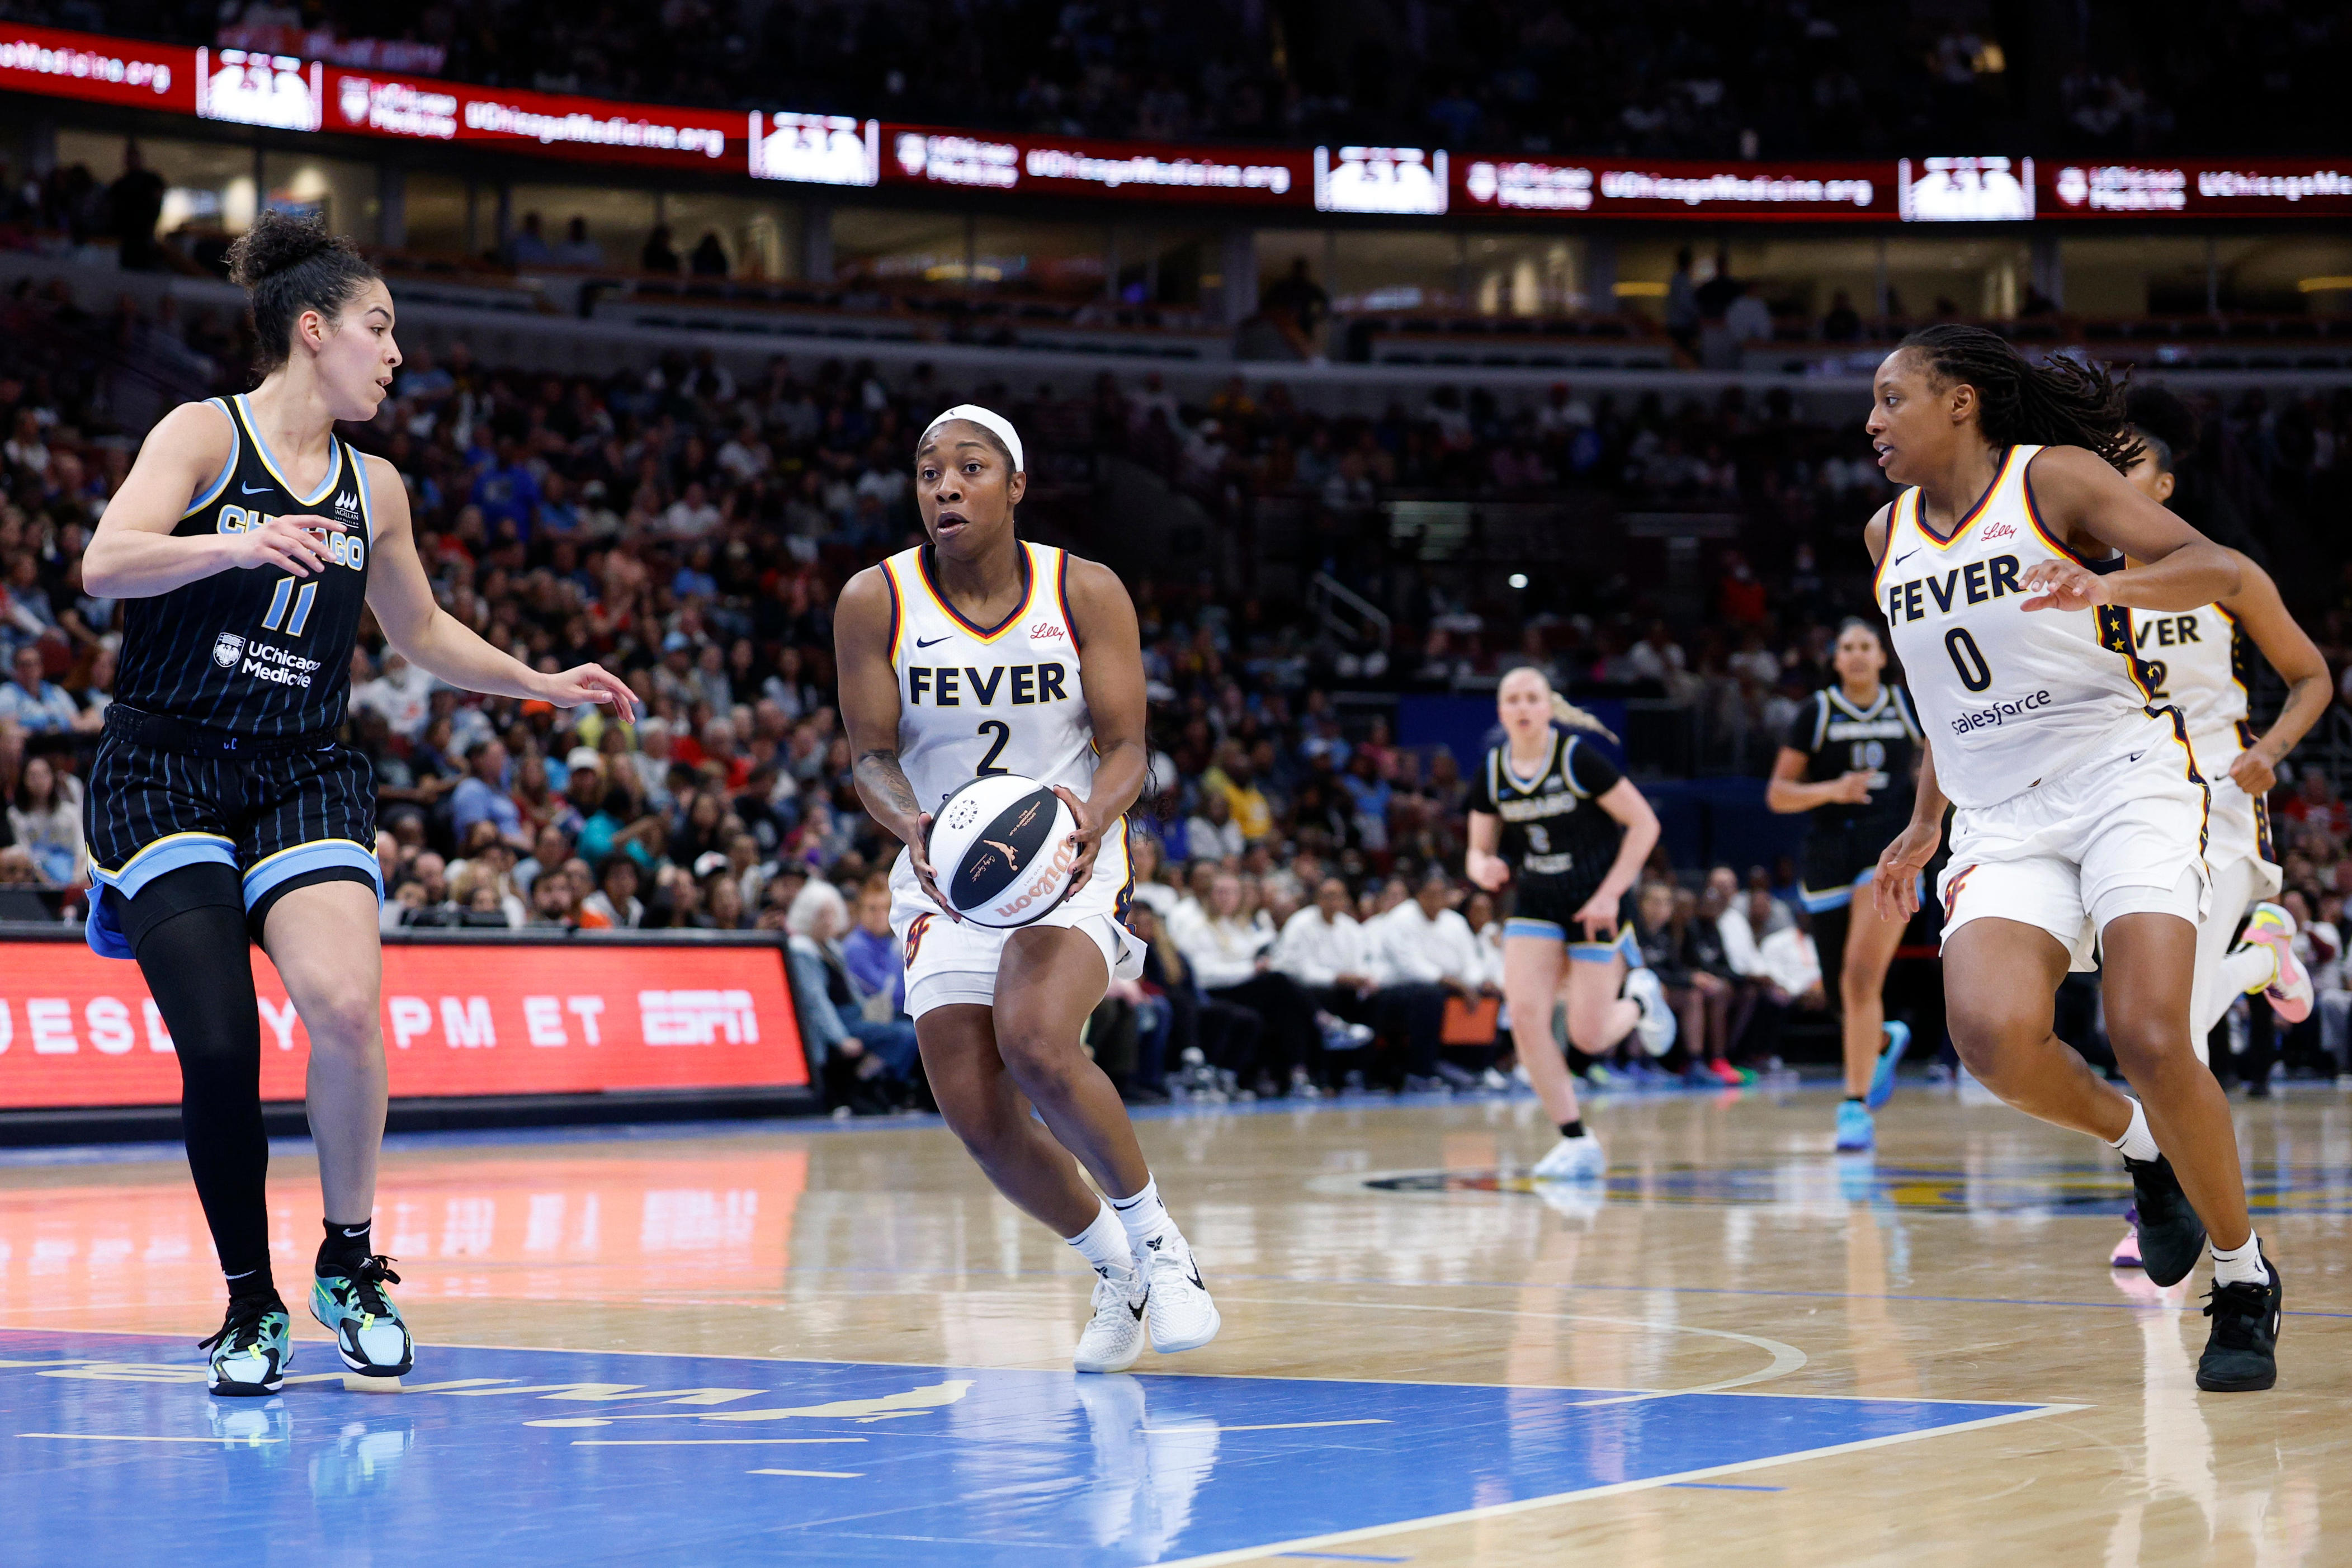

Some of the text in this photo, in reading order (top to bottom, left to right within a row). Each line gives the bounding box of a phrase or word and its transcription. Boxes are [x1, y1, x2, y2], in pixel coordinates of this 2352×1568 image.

[335, 509, 358, 520] AGELLAN
[1981, 522, 2017, 542] Lilly
[261, 576, 318, 637] 11
[1889, 554, 2029, 627] FEVER
[1030, 623, 1065, 641] Lilly
[2136, 616, 2202, 649] VER
[249, 641, 321, 673] UChicago
[1945, 627, 1992, 692] 0
[909, 662, 1069, 707] FEVER
[1952, 690, 2051, 735] salesforce
[976, 720, 1010, 777] 2
[1018, 809, 1028, 819] BALL
[1022, 812, 1036, 826] OFFICIAL
[522, 994, 605, 1047] ET
[637, 989, 759, 1046] ESPN
